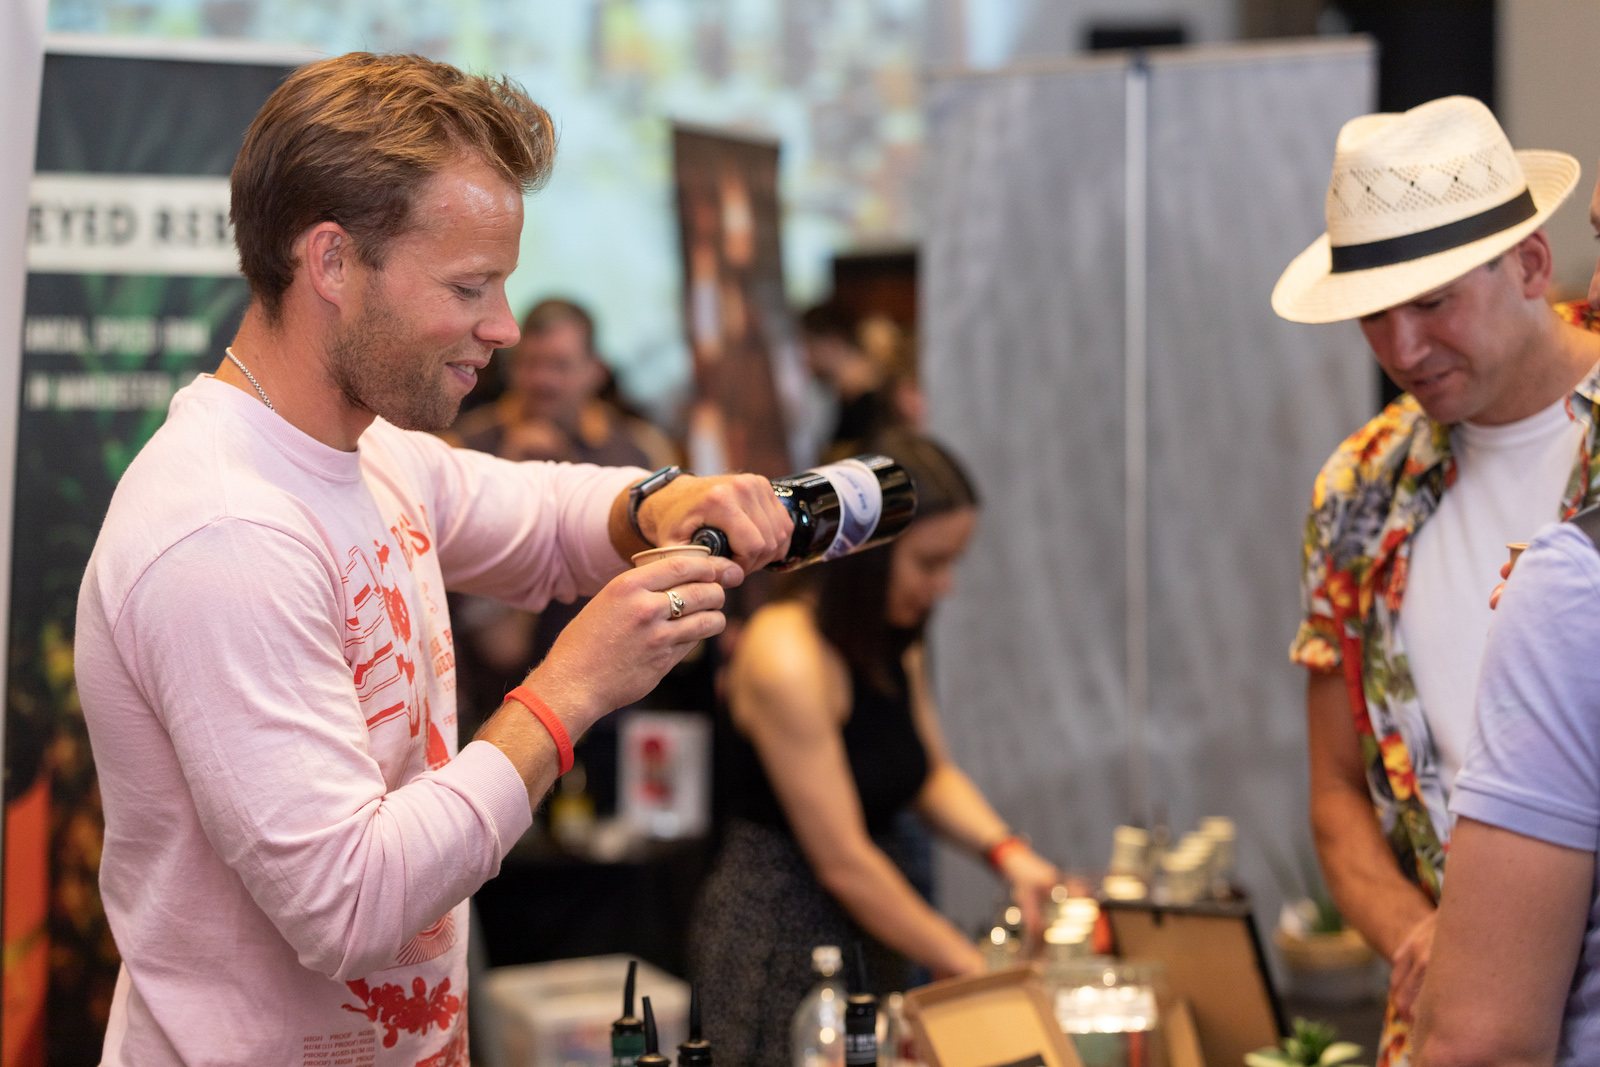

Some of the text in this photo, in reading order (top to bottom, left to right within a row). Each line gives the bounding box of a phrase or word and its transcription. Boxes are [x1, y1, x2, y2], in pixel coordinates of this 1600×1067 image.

[29, 205, 138, 246] EYED
[330, 1032, 352, 1040] PROOF
[330, 1049, 350, 1057] AGED
